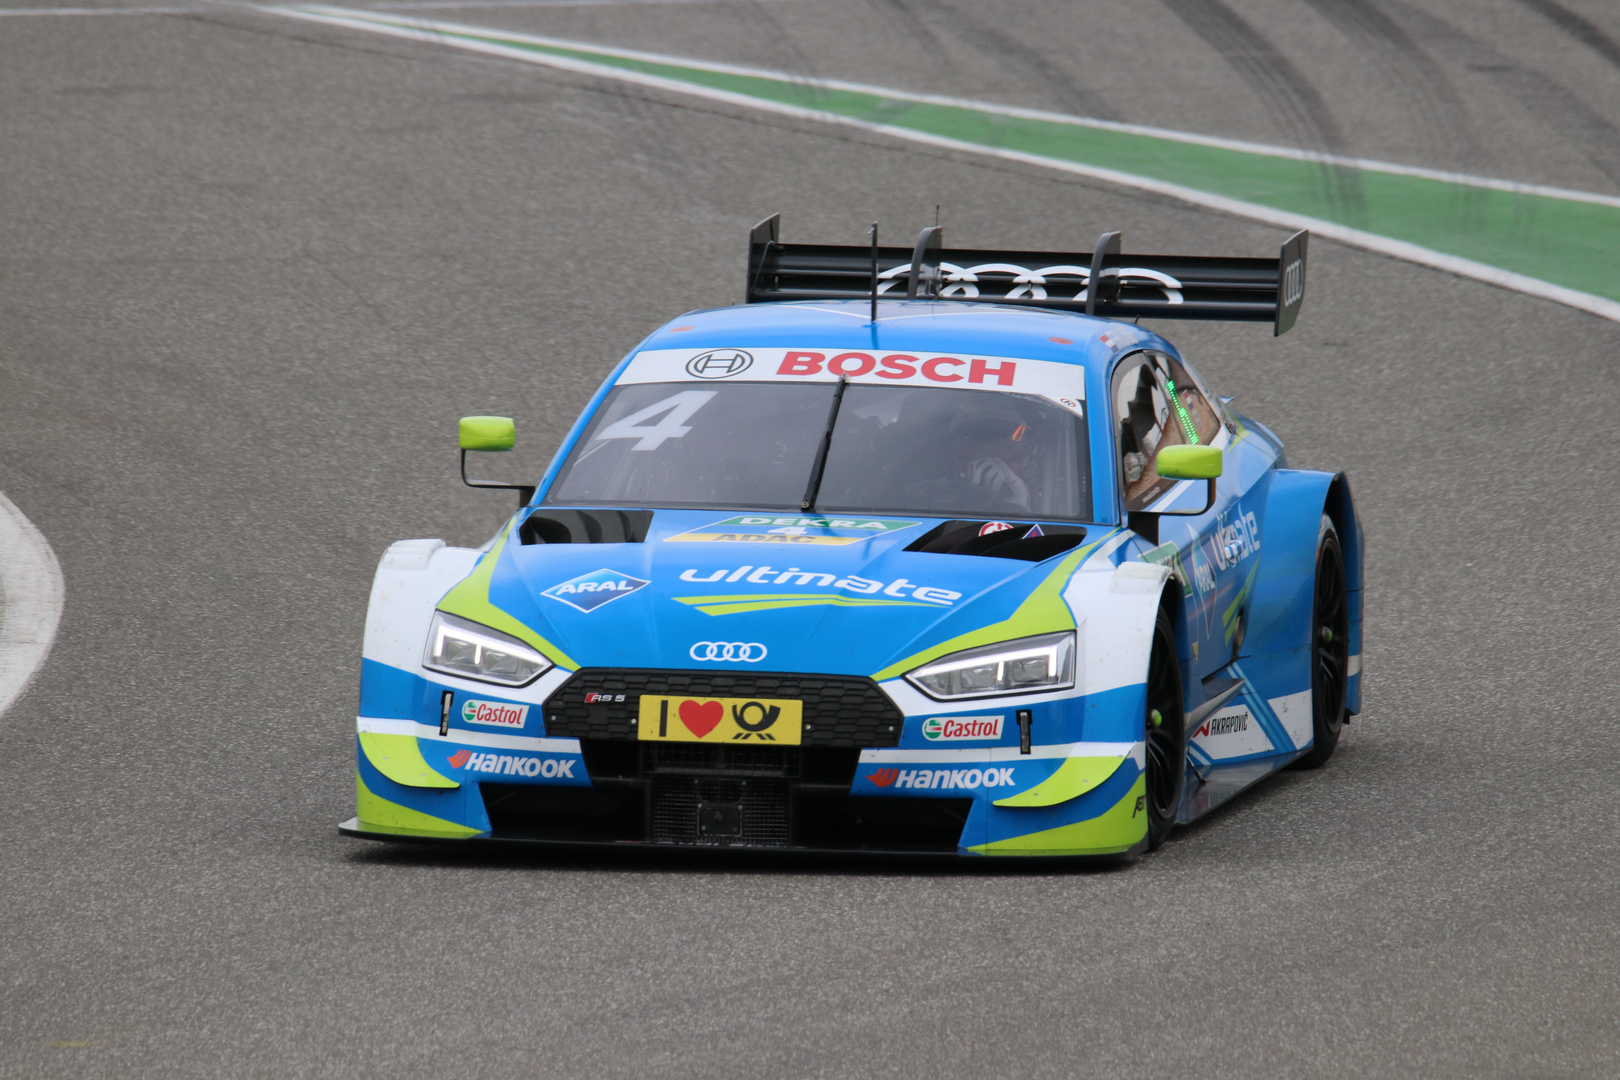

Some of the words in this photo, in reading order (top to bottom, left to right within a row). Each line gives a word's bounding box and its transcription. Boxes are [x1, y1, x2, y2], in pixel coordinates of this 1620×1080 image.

[776, 351, 1016, 386] BOSCH
[595, 390, 719, 451] 4
[739, 517, 888, 530] DEKRA
[713, 534, 815, 544] ADAC
[556, 580, 635, 595] ARAL
[679, 565, 963, 606] ultimate
[476, 704, 523, 725] Castrol
[659, 700, 669, 738] I
[943, 719, 999, 738] Castrol
